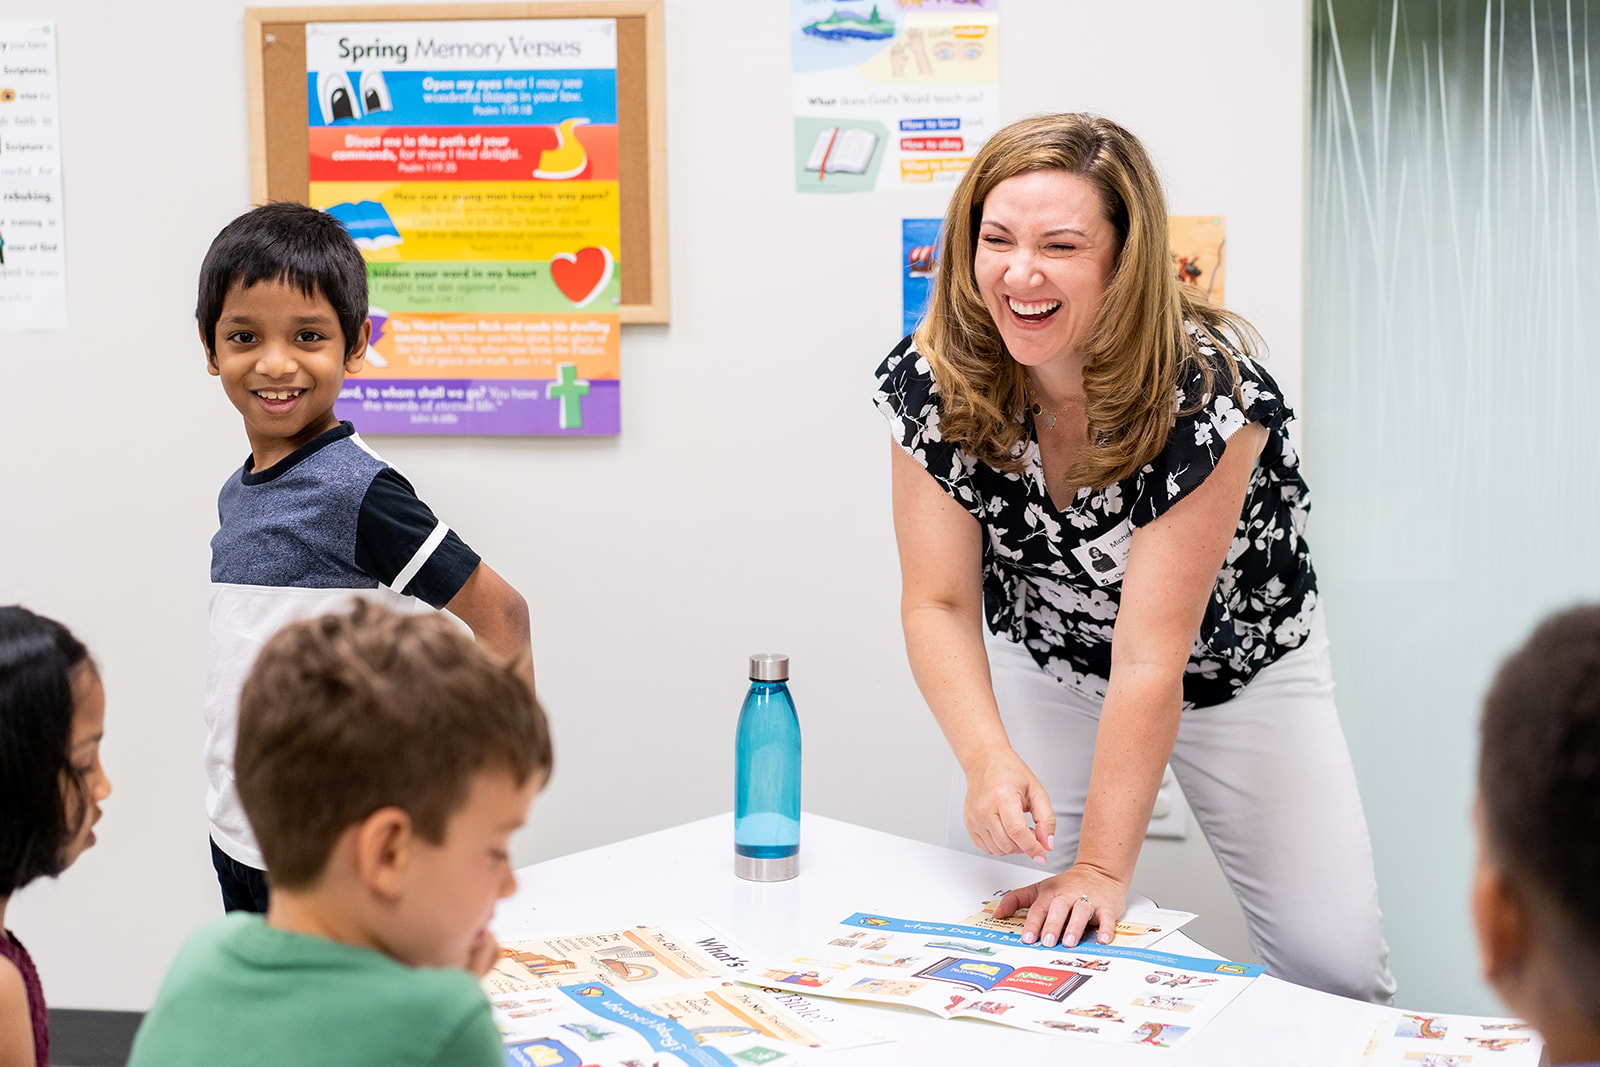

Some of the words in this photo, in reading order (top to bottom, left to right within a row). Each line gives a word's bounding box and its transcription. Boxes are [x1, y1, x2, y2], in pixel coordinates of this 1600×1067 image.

[338, 37, 407, 64] Spring
[414, 38, 505, 63] Memory
[508, 36, 582, 58] Verses
[422, 77, 455, 92] Open
[456, 81, 475, 93] my
[477, 81, 502, 93] eyes
[504, 77, 528, 91] that
[422, 91, 480, 104] wonderful
[807, 95, 837, 106] What
[345, 134, 380, 148] Direct
[383, 138, 401, 148] me
[403, 134, 415, 147] in
[418, 134, 437, 147] the
[439, 134, 466, 150] path
[468, 133, 481, 147] of
[482, 137, 509, 150] your
[332, 149, 397, 163] commands,
[399, 149, 415, 160] for
[417, 148, 447, 160] there
[456, 147, 478, 160] find
[373, 267, 410, 278] hidden
[414, 271, 439, 281] your
[442, 266, 470, 279] word
[487, 270, 503, 282] my
[506, 266, 537, 279] heart
[391, 320, 411, 332] The
[412, 320, 438, 332] Word
[439, 320, 476, 332] became
[503, 320, 523, 332] and
[524, 320, 552, 332] made
[339, 385, 364, 401] ord,
[366, 386, 379, 400] to
[381, 385, 416, 400] whom
[418, 384, 445, 399] shall
[447, 388, 464, 399] we
[467, 385, 487, 403] go?
[984, 916, 1025, 928] Gospels
[695, 937, 750, 968] What's
